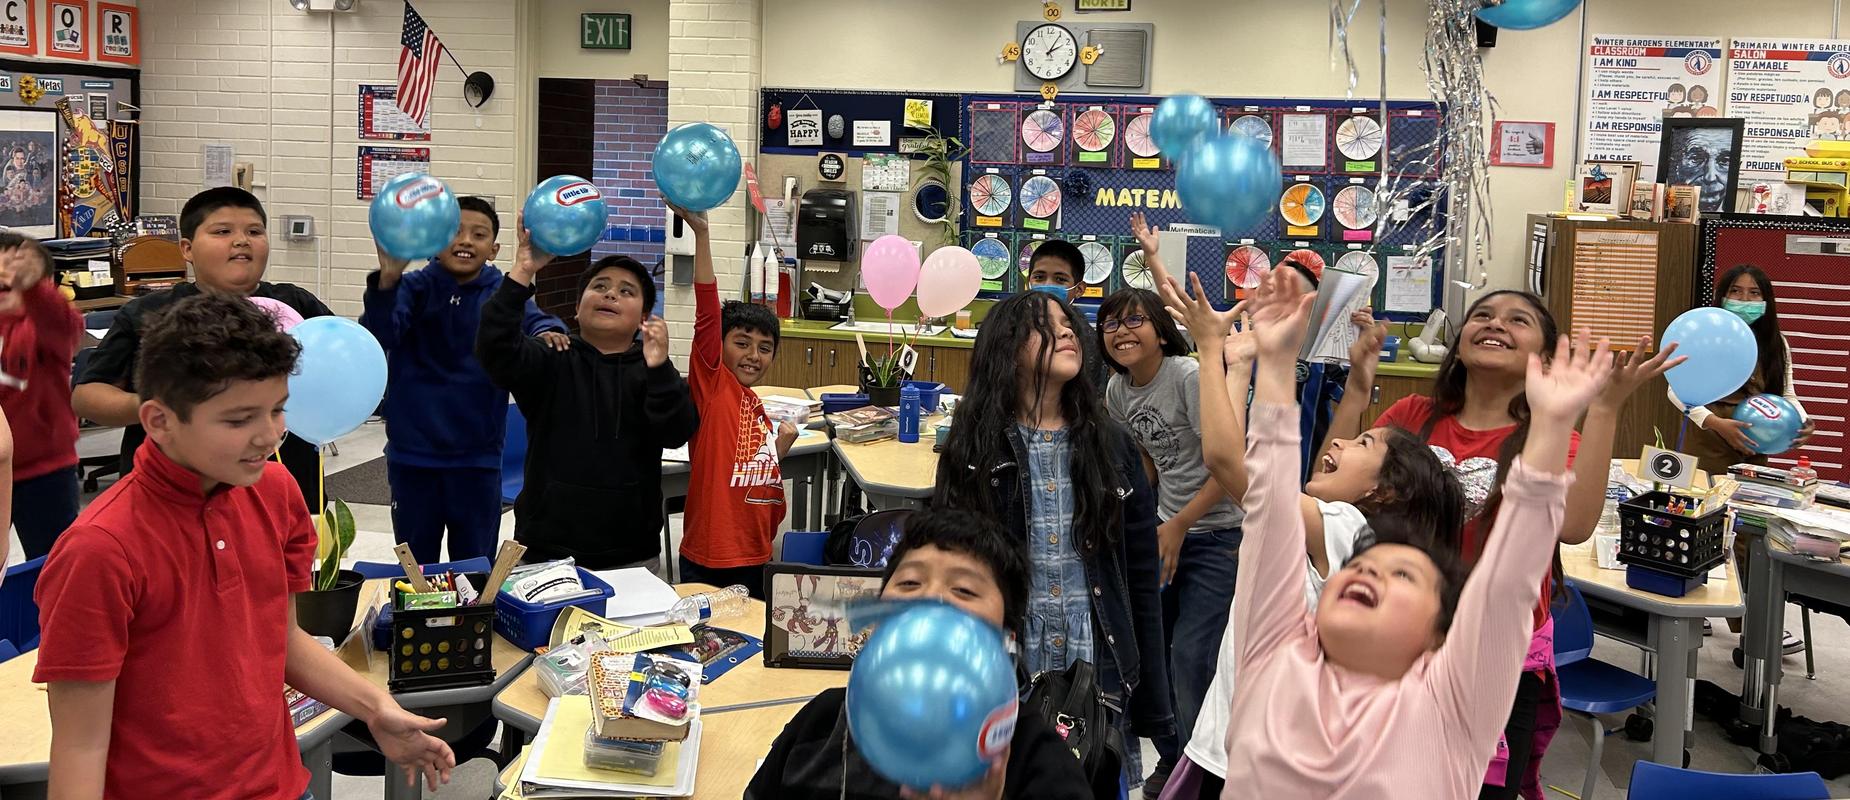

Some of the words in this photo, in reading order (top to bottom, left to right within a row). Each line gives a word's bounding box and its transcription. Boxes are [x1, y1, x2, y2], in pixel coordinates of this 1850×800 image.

[6, 1, 18, 21] C
[1047, 8, 1059, 17] 00
[61, 8, 74, 28] O
[111, 14, 122, 34] R
[584, 18, 626, 45] EXIT
[1046, 27, 1056, 35] 12
[1595, 38, 1624, 46] WINTER
[1626, 39, 1662, 47] GARDENS
[1665, 40, 1715, 48] ELEMENTARY
[1734, 41, 1777, 50] PRIMARIA
[1781, 43, 1815, 51] WINTER
[1819, 44, 1850, 52] GARDE
[1008, 46, 1019, 56] 45
[1025, 48, 1031, 56] 9
[1084, 50, 1092, 60] 15
[1594, 46, 1647, 56] CLASSROOM
[1028, 58, 1034, 66] 8
[1064, 59, 1070, 67] 4
[1600, 58, 1614, 66] AM
[1616, 58, 1637, 67] KIND
[1733, 60, 1751, 69] SOY
[1753, 61, 1789, 70] AMABLE
[1046, 69, 1051, 77] 6
[38, 79, 61, 91] Metas
[1044, 86, 1056, 95] 30
[1597, 90, 1612, 98] AM
[1613, 90, 1669, 100] RESPECTFUL
[1731, 92, 1749, 101] SOY
[1750, 93, 1810, 103] RESPETUOSO/A
[1595, 121, 1609, 130] AM
[790, 129, 819, 138] HAPPY
[1748, 128, 1811, 138] RESPONSABLE
[562, 189, 581, 200] little
[1659, 459, 1673, 474] 2
